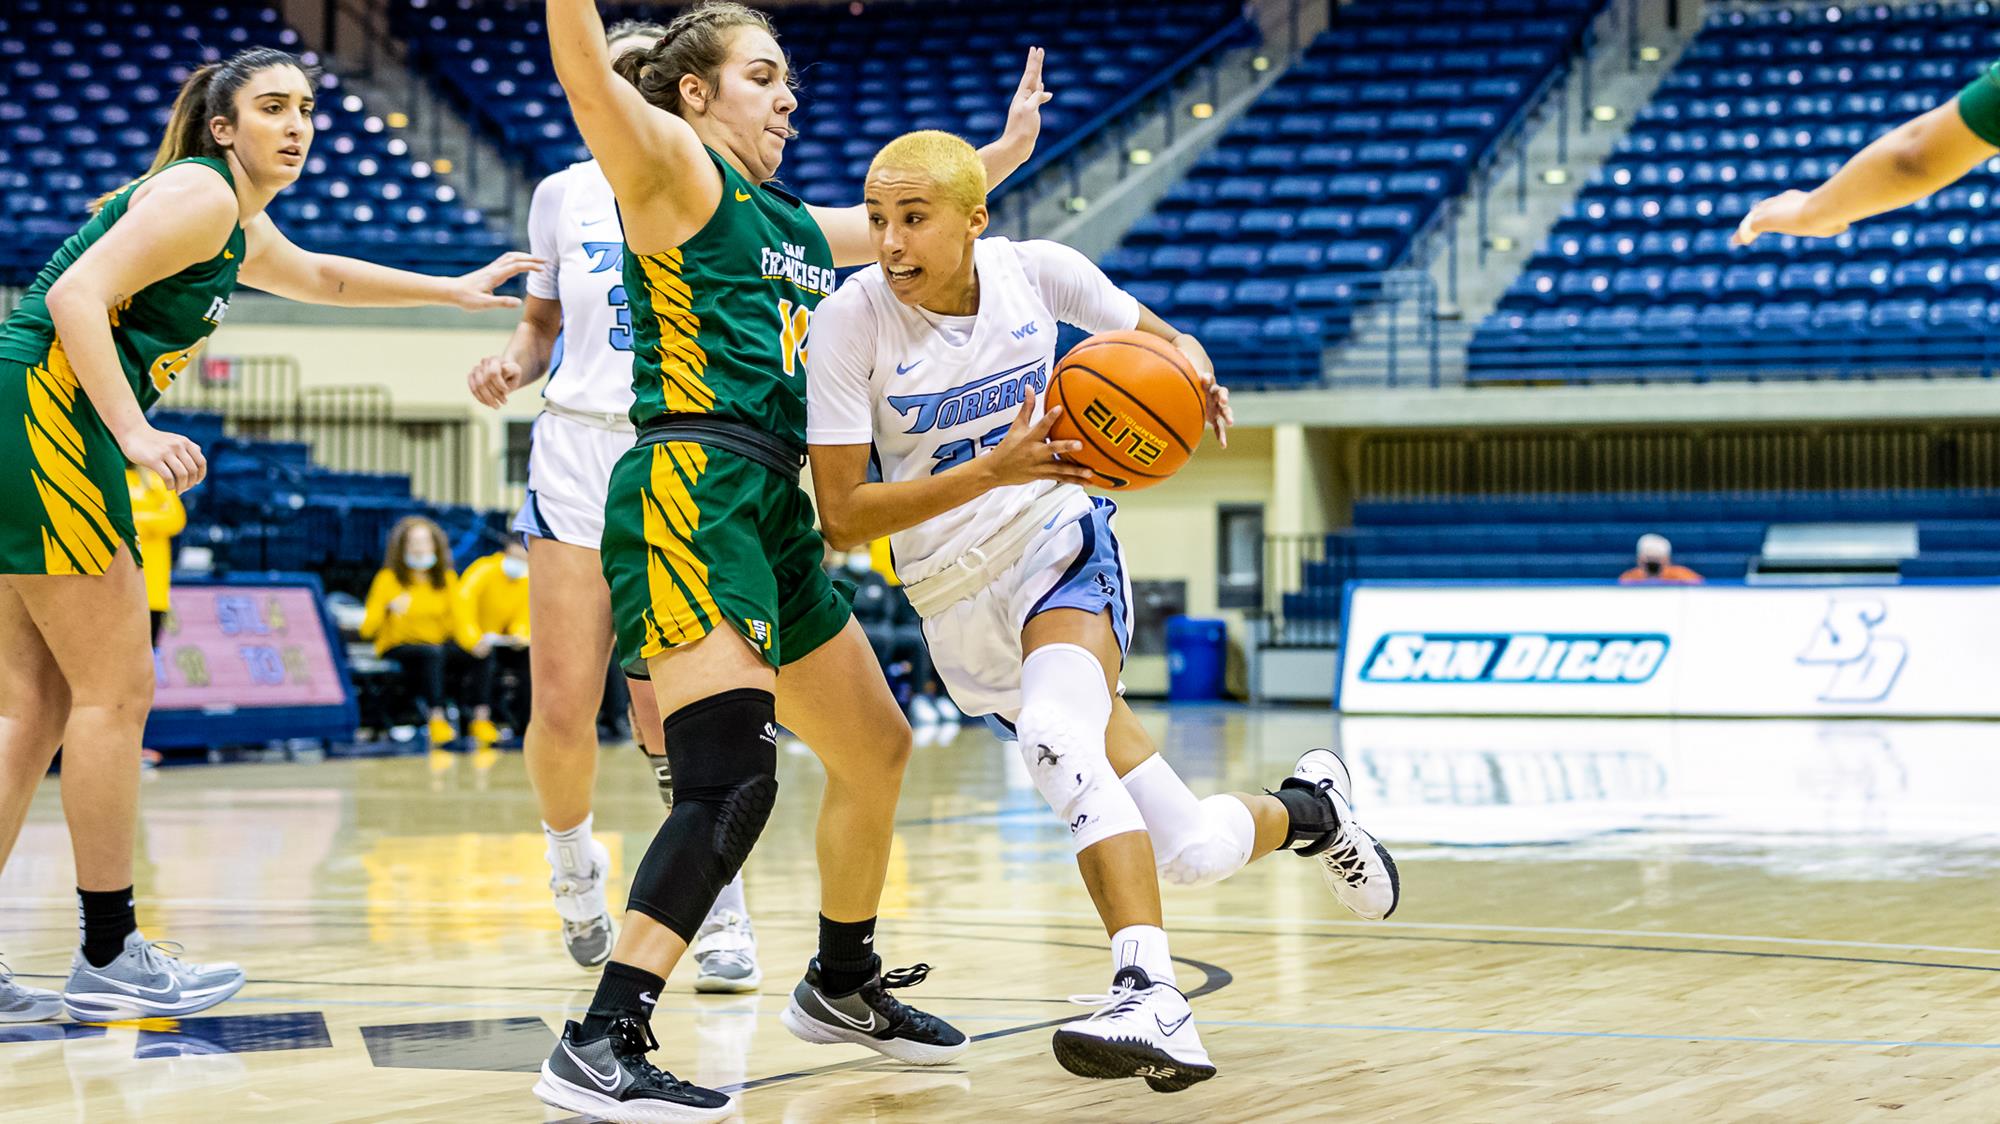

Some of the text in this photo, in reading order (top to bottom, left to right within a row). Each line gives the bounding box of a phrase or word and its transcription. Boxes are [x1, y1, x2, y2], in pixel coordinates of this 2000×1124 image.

[782, 241, 806, 261] SAN
[887, 355, 1048, 434] TOREROS
[1081, 397, 1164, 468] ELITE
[1120, 411, 1169, 450] CHAMPION
[1366, 633, 1497, 681] SAN
